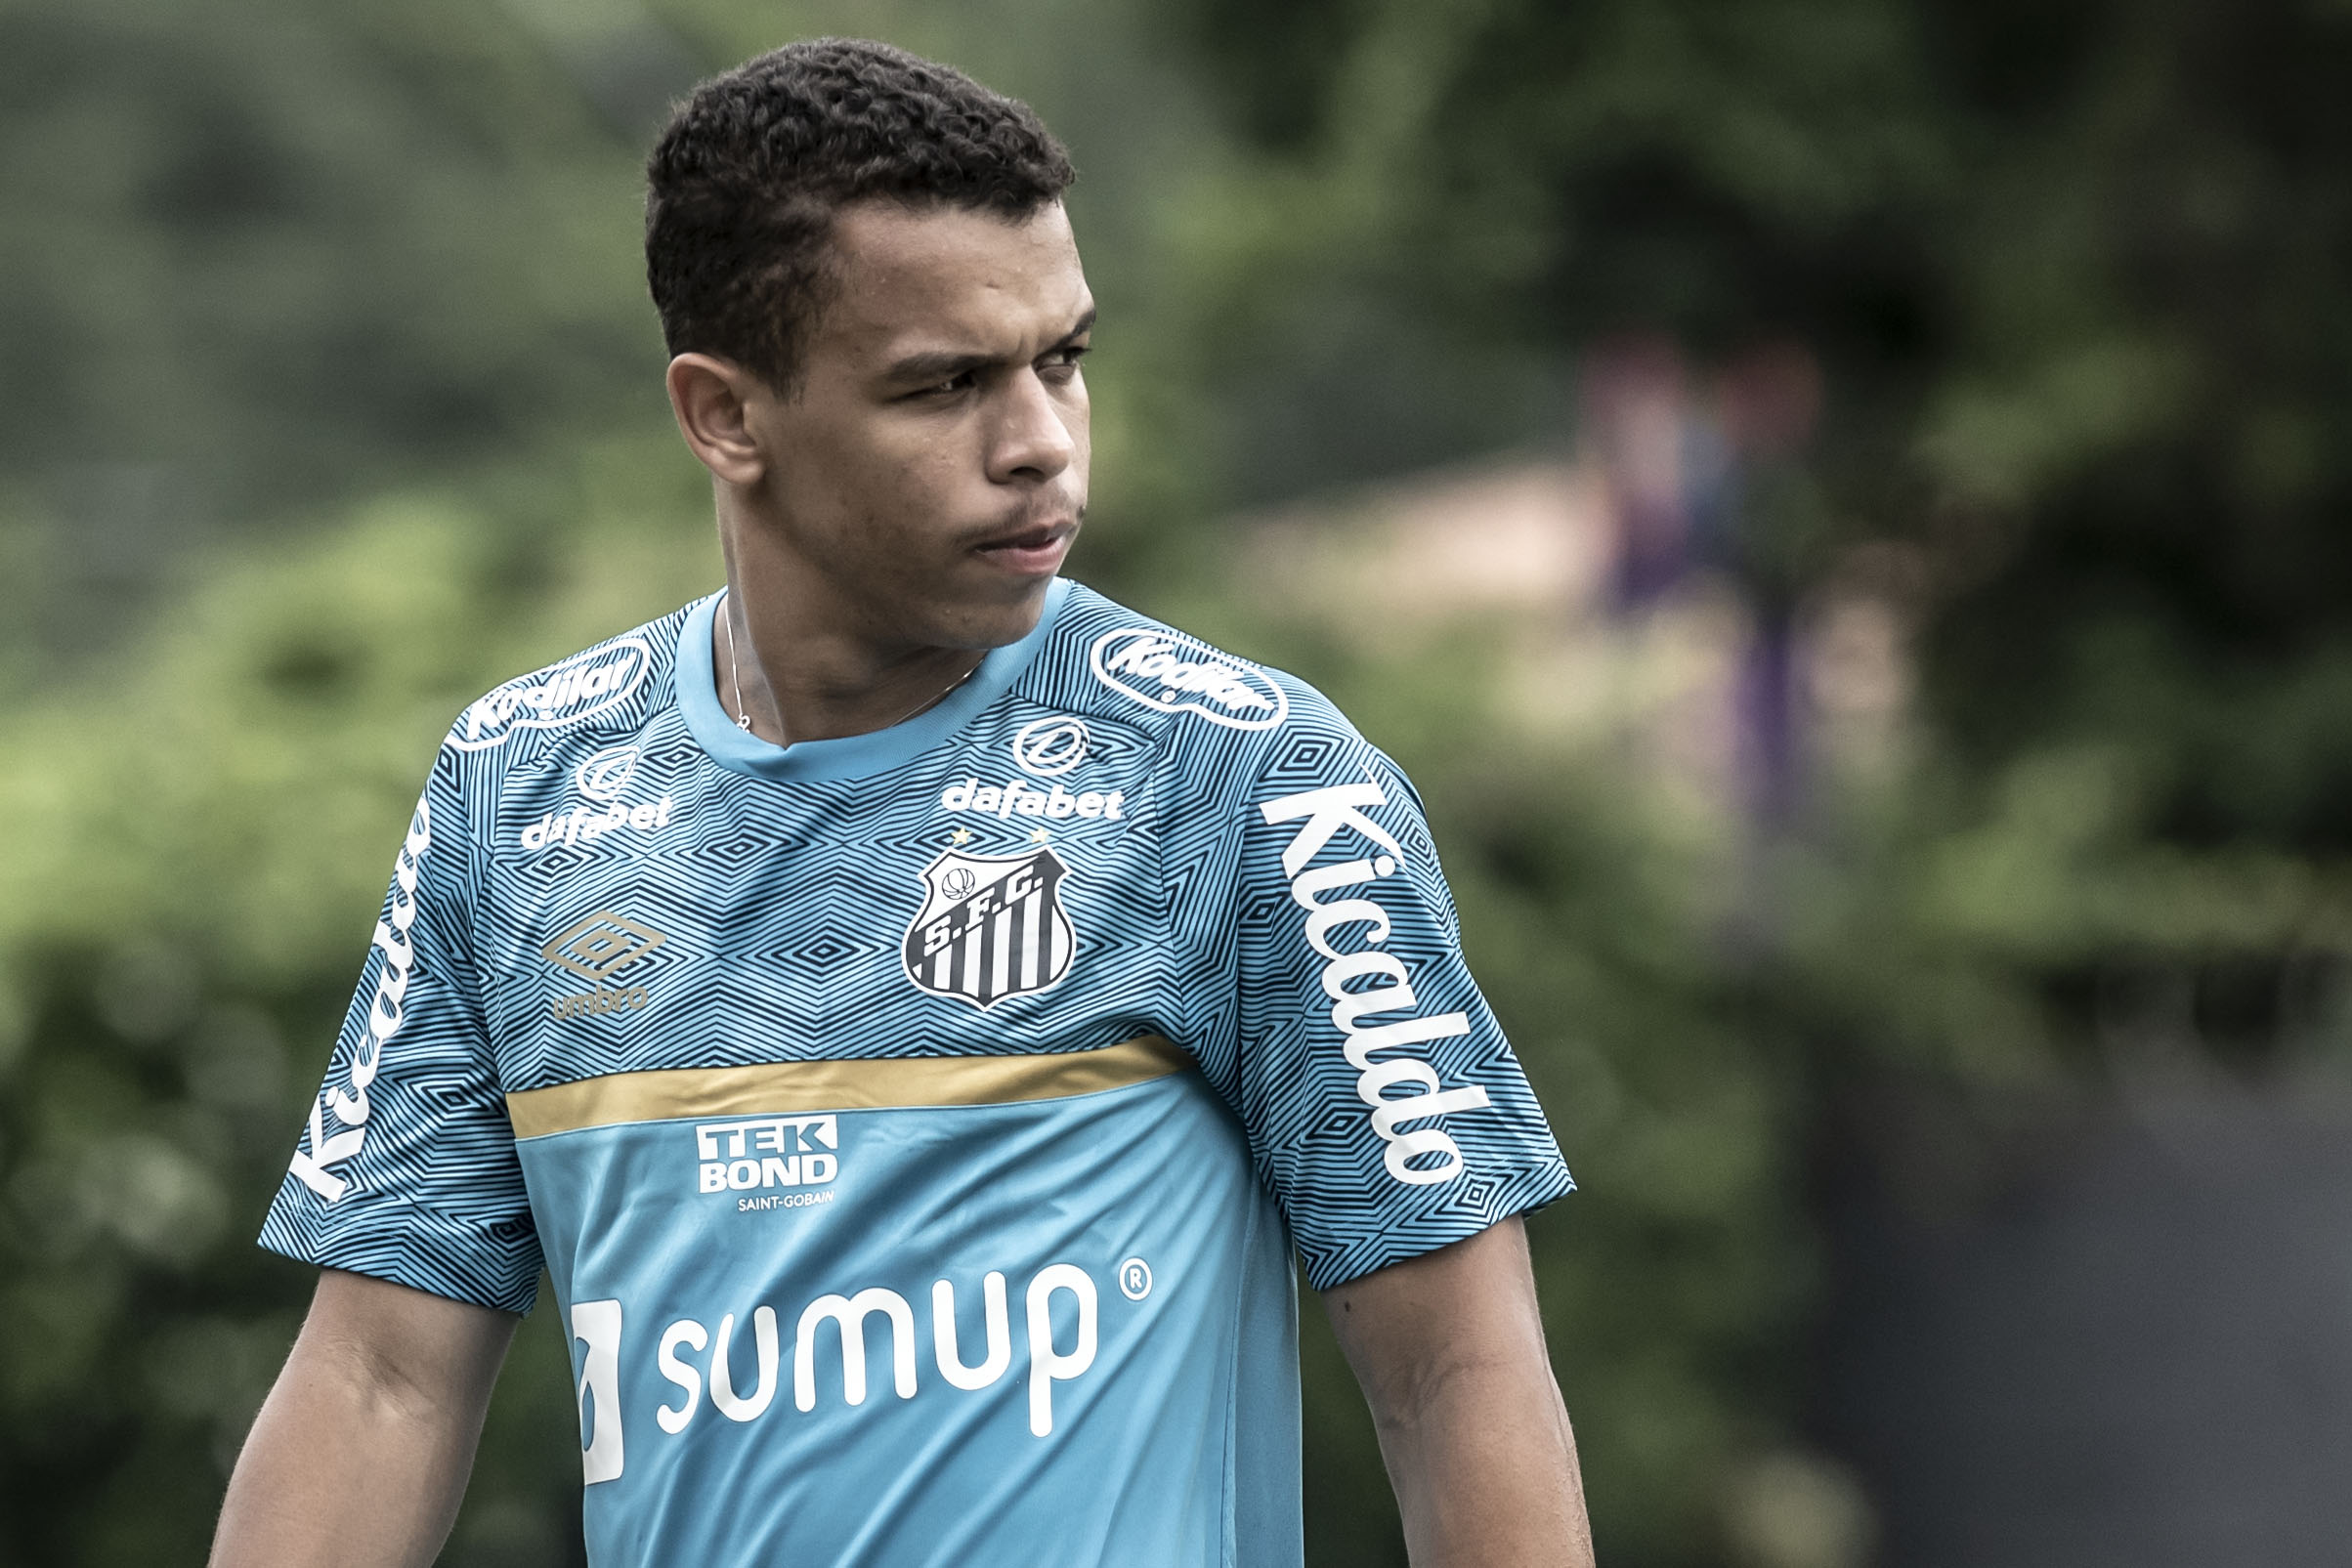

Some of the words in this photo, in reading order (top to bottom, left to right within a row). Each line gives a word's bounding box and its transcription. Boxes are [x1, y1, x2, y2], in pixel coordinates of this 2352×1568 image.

[940, 778, 1127, 820] dafabet
[520, 794, 674, 850] dafabet
[1258, 760, 1493, 1186] Kicaldo
[552, 985, 649, 1021] umbro
[704, 1121, 833, 1161] TEK
[699, 1153, 838, 1194] BOND
[737, 1190, 834, 1212] SAINT-GOBAIN
[656, 1262, 1099, 1438] sumup
